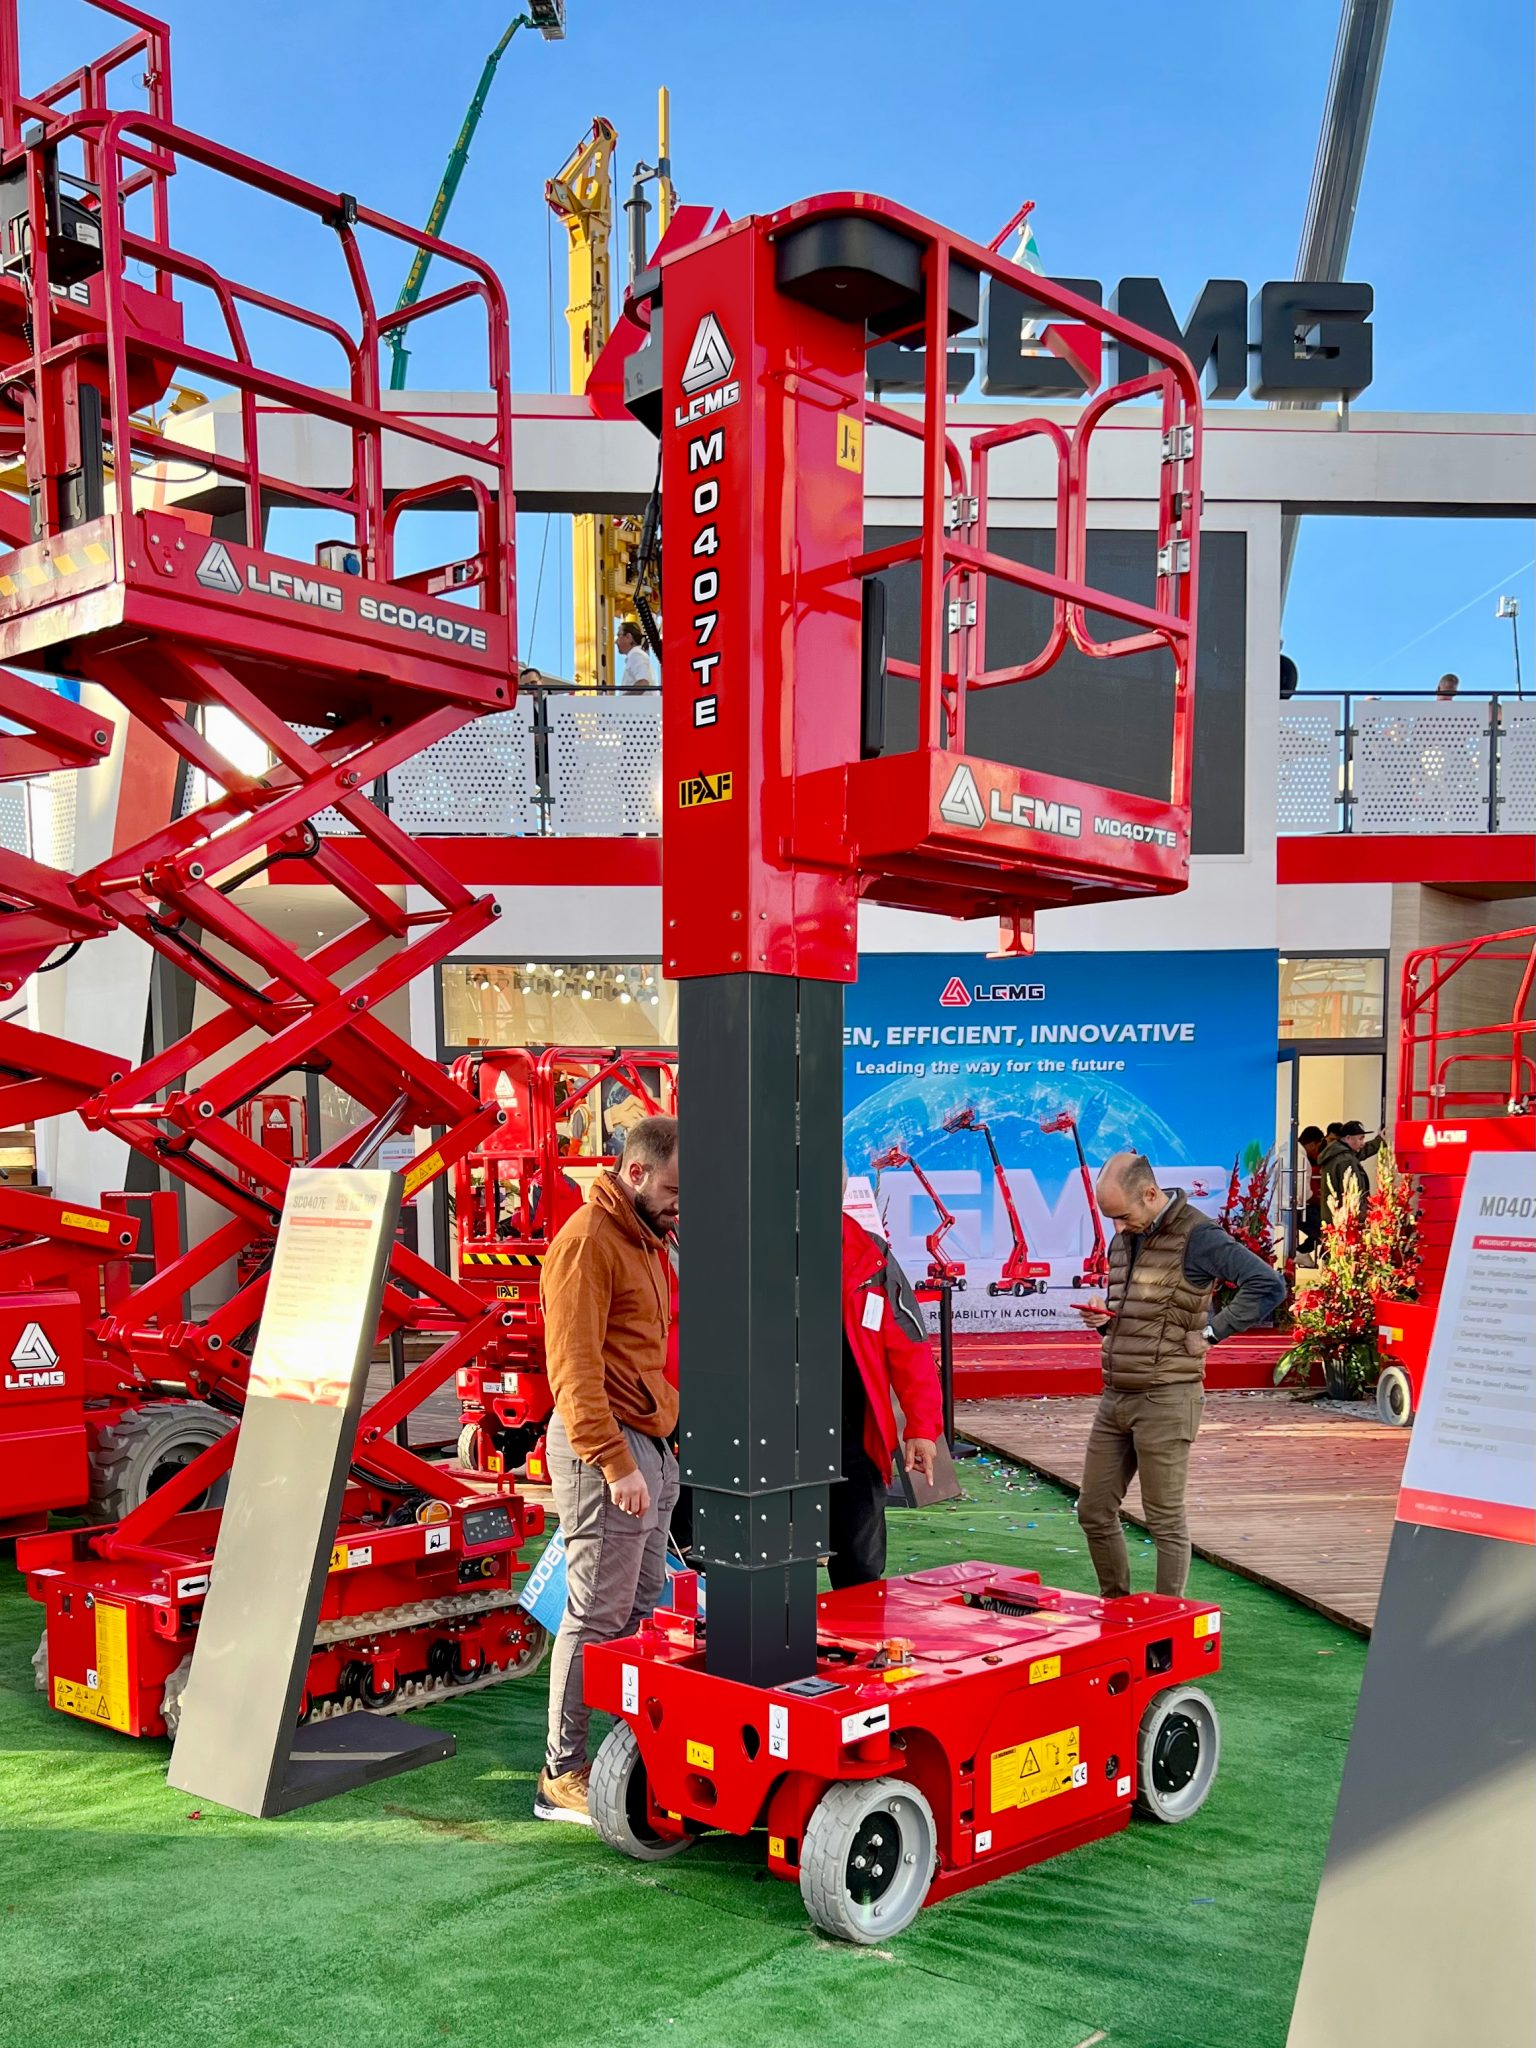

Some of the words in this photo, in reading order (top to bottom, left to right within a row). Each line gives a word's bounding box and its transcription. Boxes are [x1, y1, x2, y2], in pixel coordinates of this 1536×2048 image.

[675, 381, 740, 428] LGMG
[247, 565, 342, 612] LGMG
[681, 771, 731, 807] IPAF
[989, 789, 1081, 838] LGMG
[975, 984, 1045, 1000] LGMG
[886, 1025, 1024, 1047] EFFICIENT,
[1030, 1023, 1195, 1044] INNOVATIVE
[856, 1061, 925, 1078] Leading
[931, 1060, 960, 1074] the
[966, 1062, 1001, 1076] way
[1006, 1059, 1031, 1073] for
[1037, 1059, 1066, 1072] the
[1071, 1058, 1126, 1072] future
[498, 1286, 518, 1299] IPAF
[930, 1309, 997, 1320] RABILITY
[1000, 1308, 1011, 1318] IN
[1014, 1308, 1056, 1318] ACTION
[5, 1371, 65, 1389] LGMG
